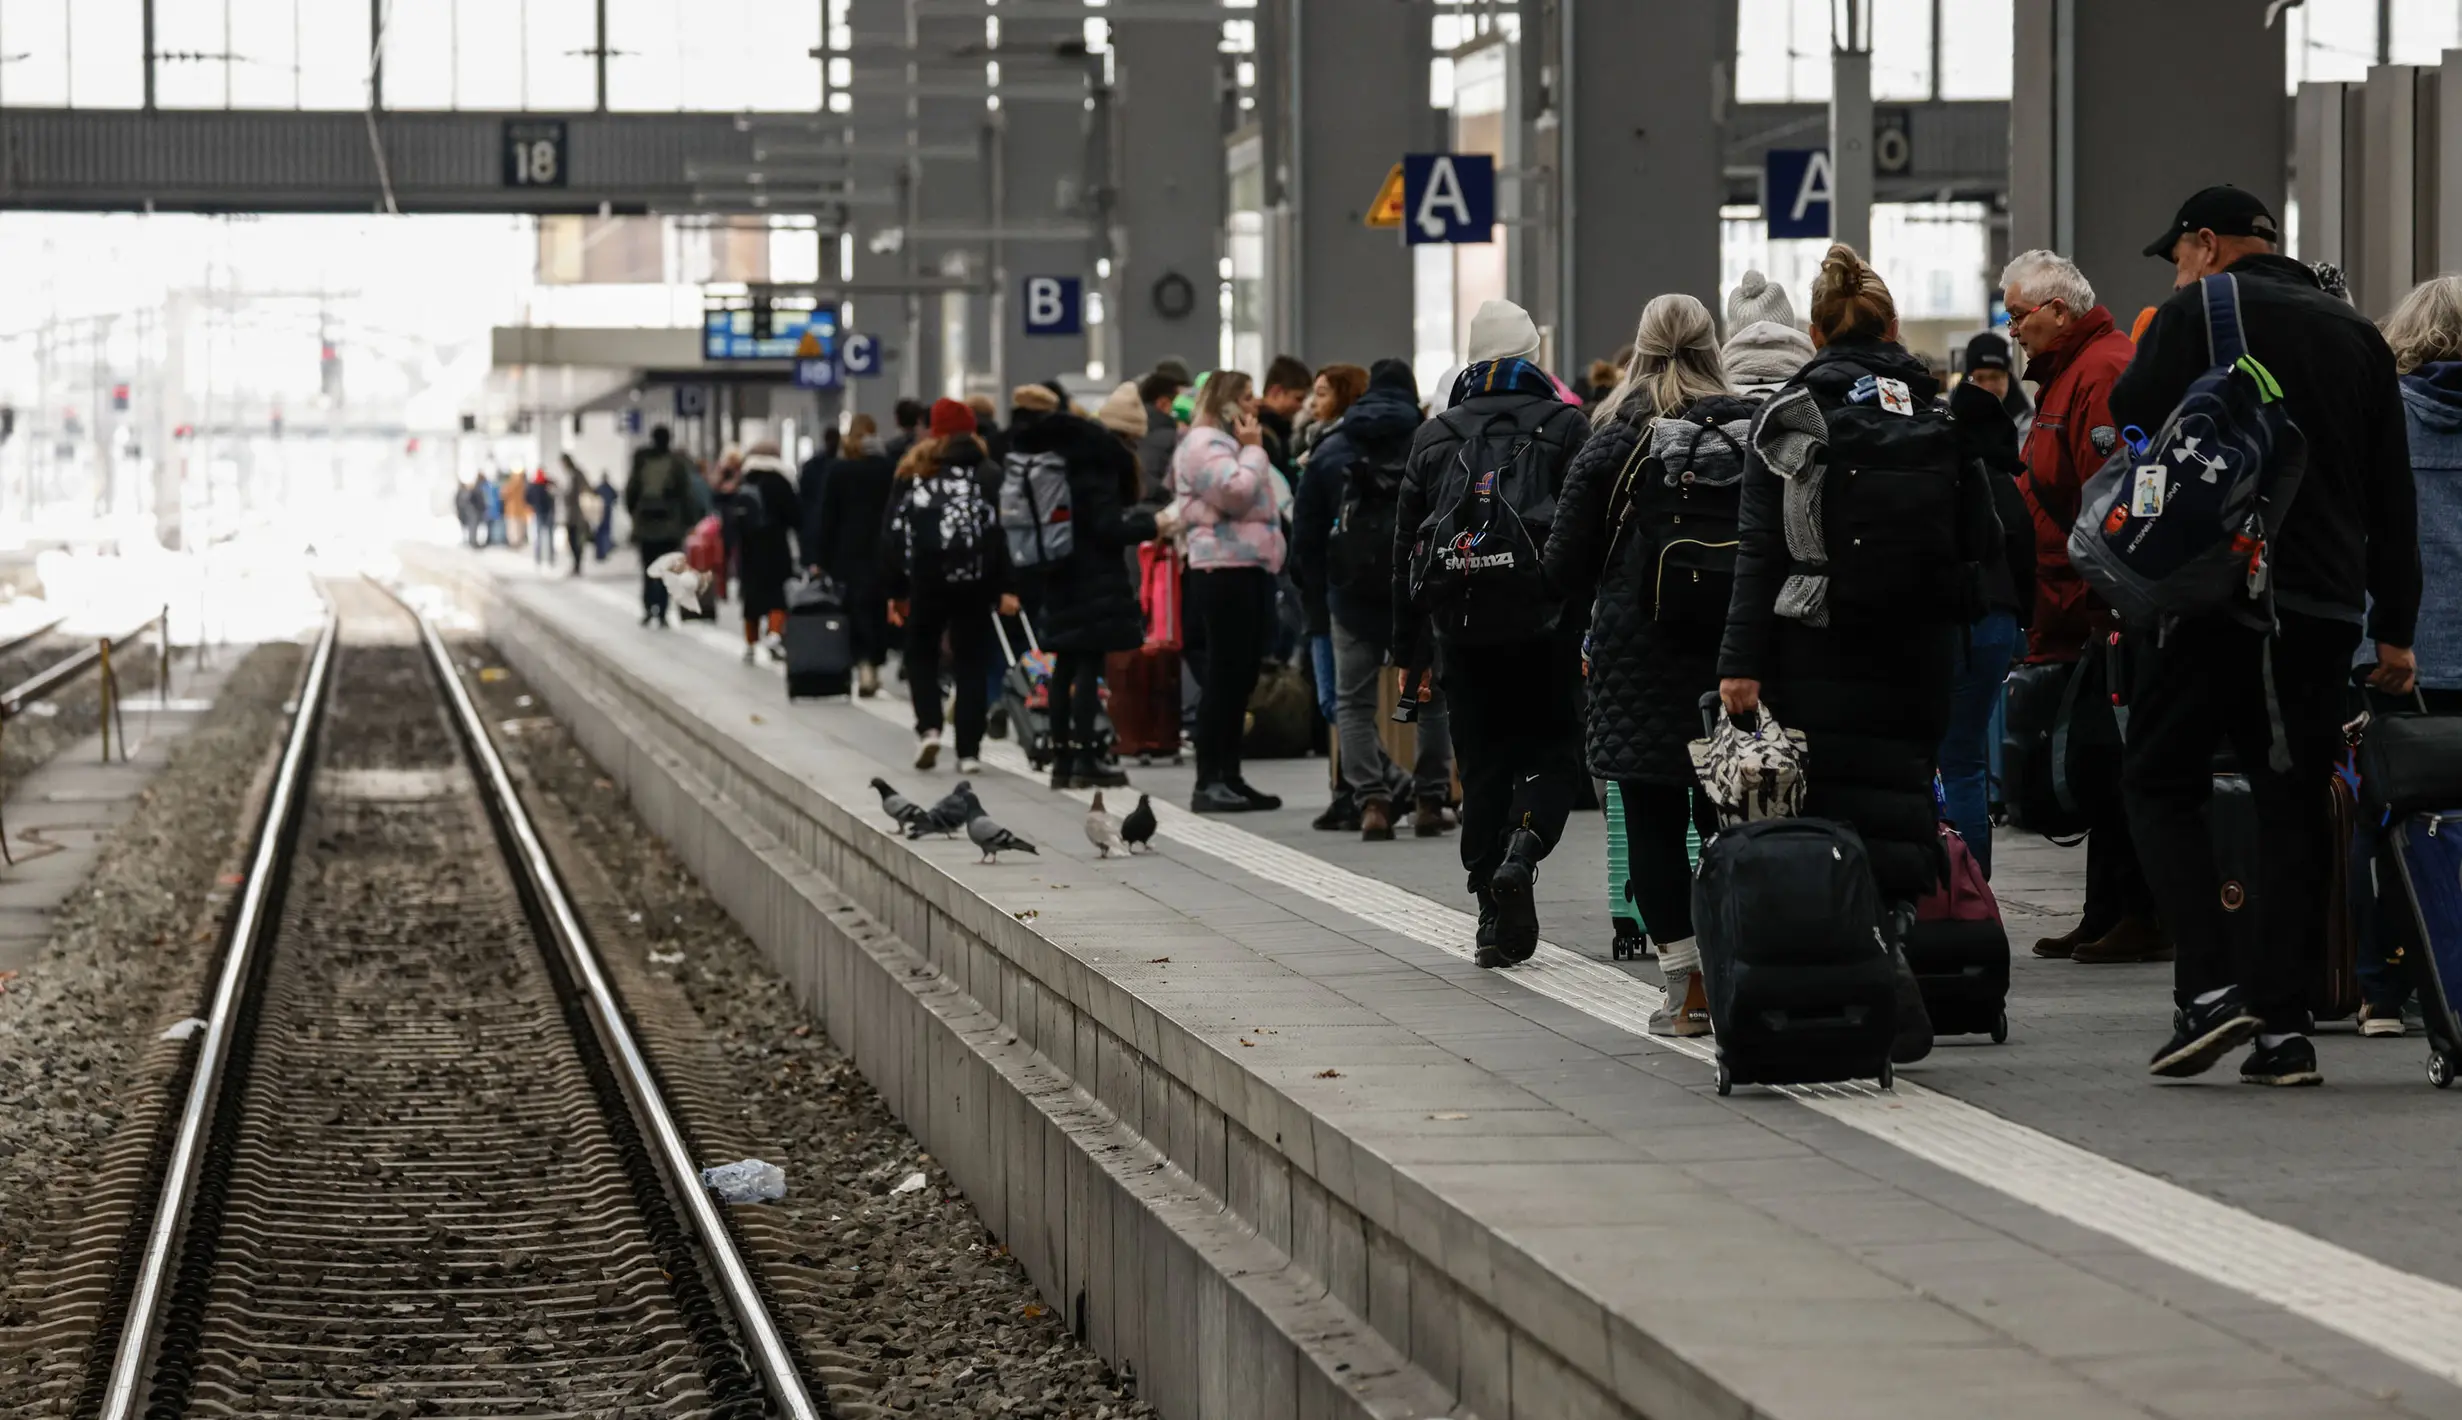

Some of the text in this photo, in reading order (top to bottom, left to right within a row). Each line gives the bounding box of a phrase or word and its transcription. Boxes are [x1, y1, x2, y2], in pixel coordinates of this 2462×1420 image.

[512, 140, 558, 184] 18
[1877, 127, 1908, 171] 0
[1415, 156, 1471, 227] A
[1790, 151, 1831, 221] A
[1029, 277, 1064, 325] B
[843, 333, 871, 372] C
